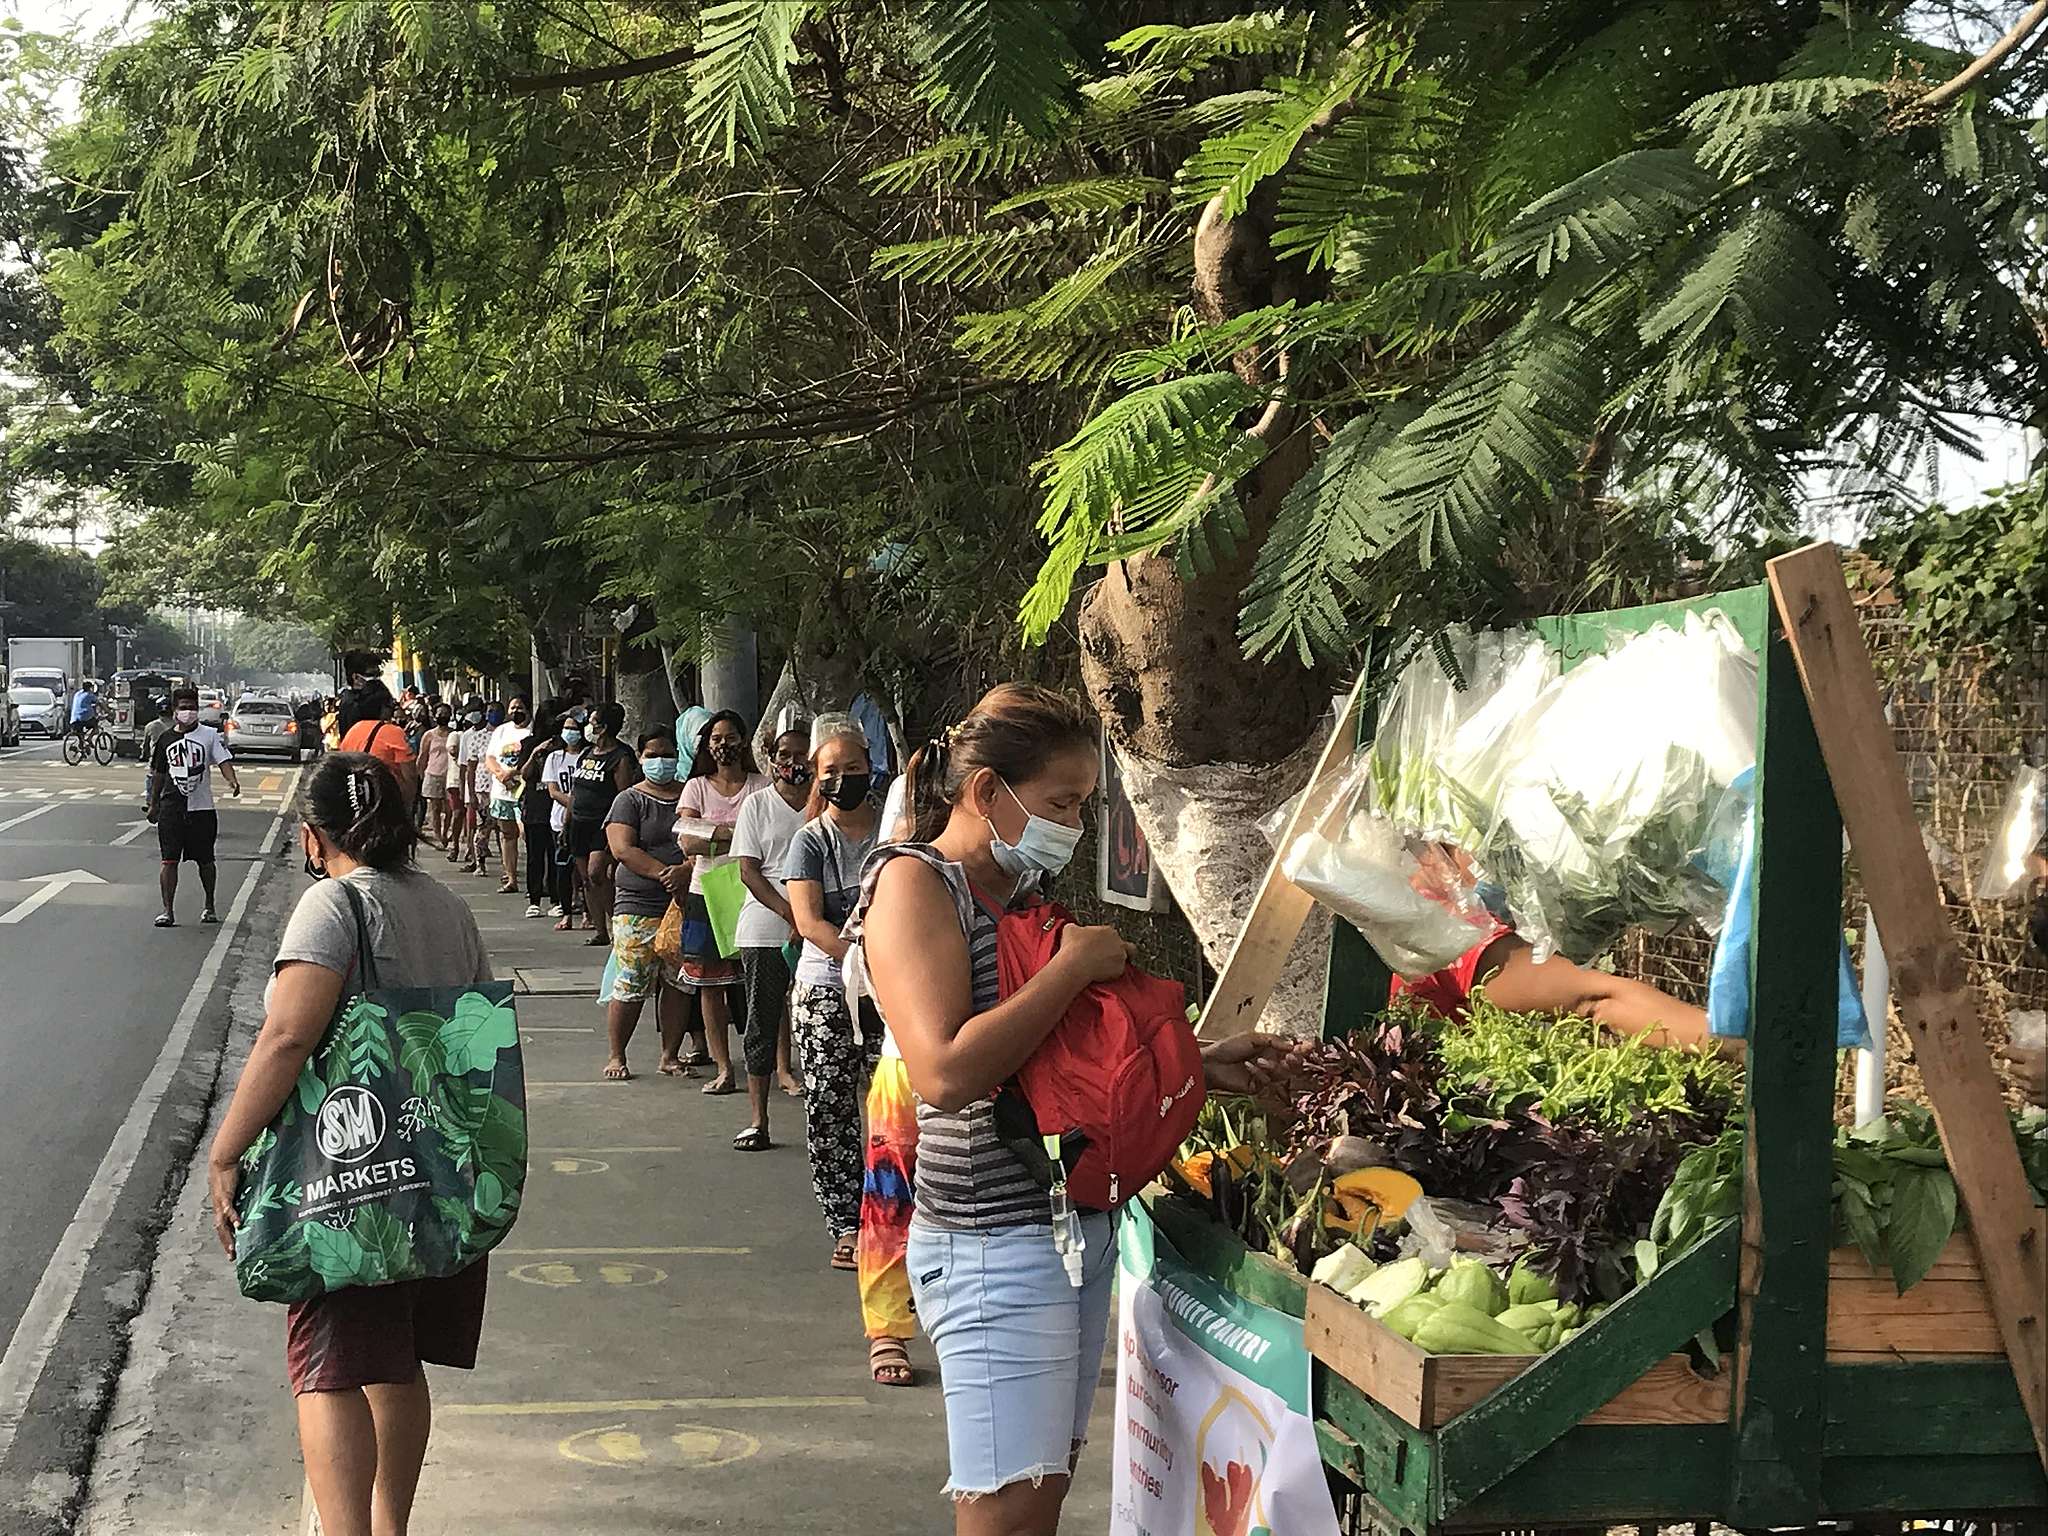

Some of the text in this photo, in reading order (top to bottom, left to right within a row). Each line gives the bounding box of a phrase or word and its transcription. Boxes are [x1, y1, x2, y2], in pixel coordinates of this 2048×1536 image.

[573, 768, 605, 782] WISH
[581, 758, 606, 771] YOU
[322, 1091, 378, 1156] SM
[306, 1157, 417, 1203] MARKETS
[1205, 1316, 1272, 1363] PANTRY
